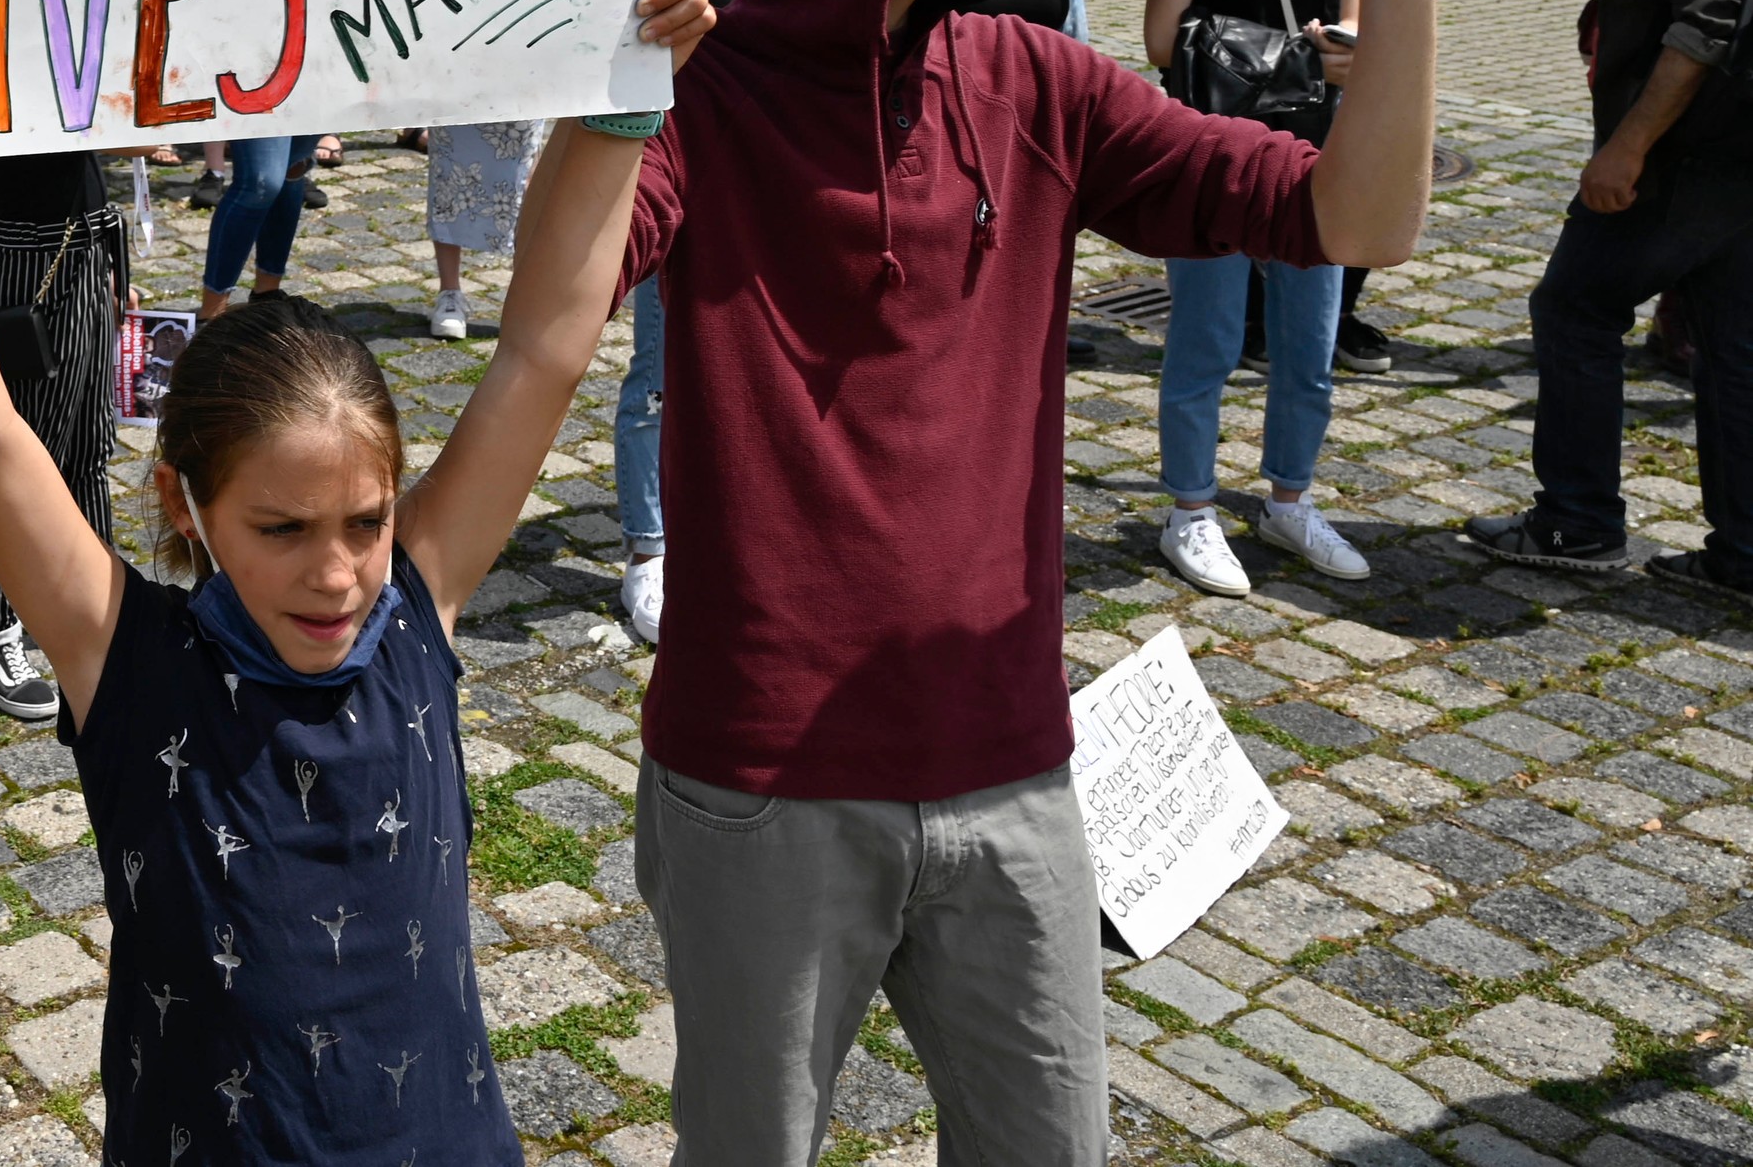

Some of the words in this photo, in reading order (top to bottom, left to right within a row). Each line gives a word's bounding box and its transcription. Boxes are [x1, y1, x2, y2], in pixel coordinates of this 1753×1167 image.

[133, 317, 143, 371] Rebellion
[1174, 700, 1194, 729] der
[1084, 783, 1149, 858] ropäischen
[1102, 864, 1162, 918] Globus
[1156, 843, 1178, 870] zu
